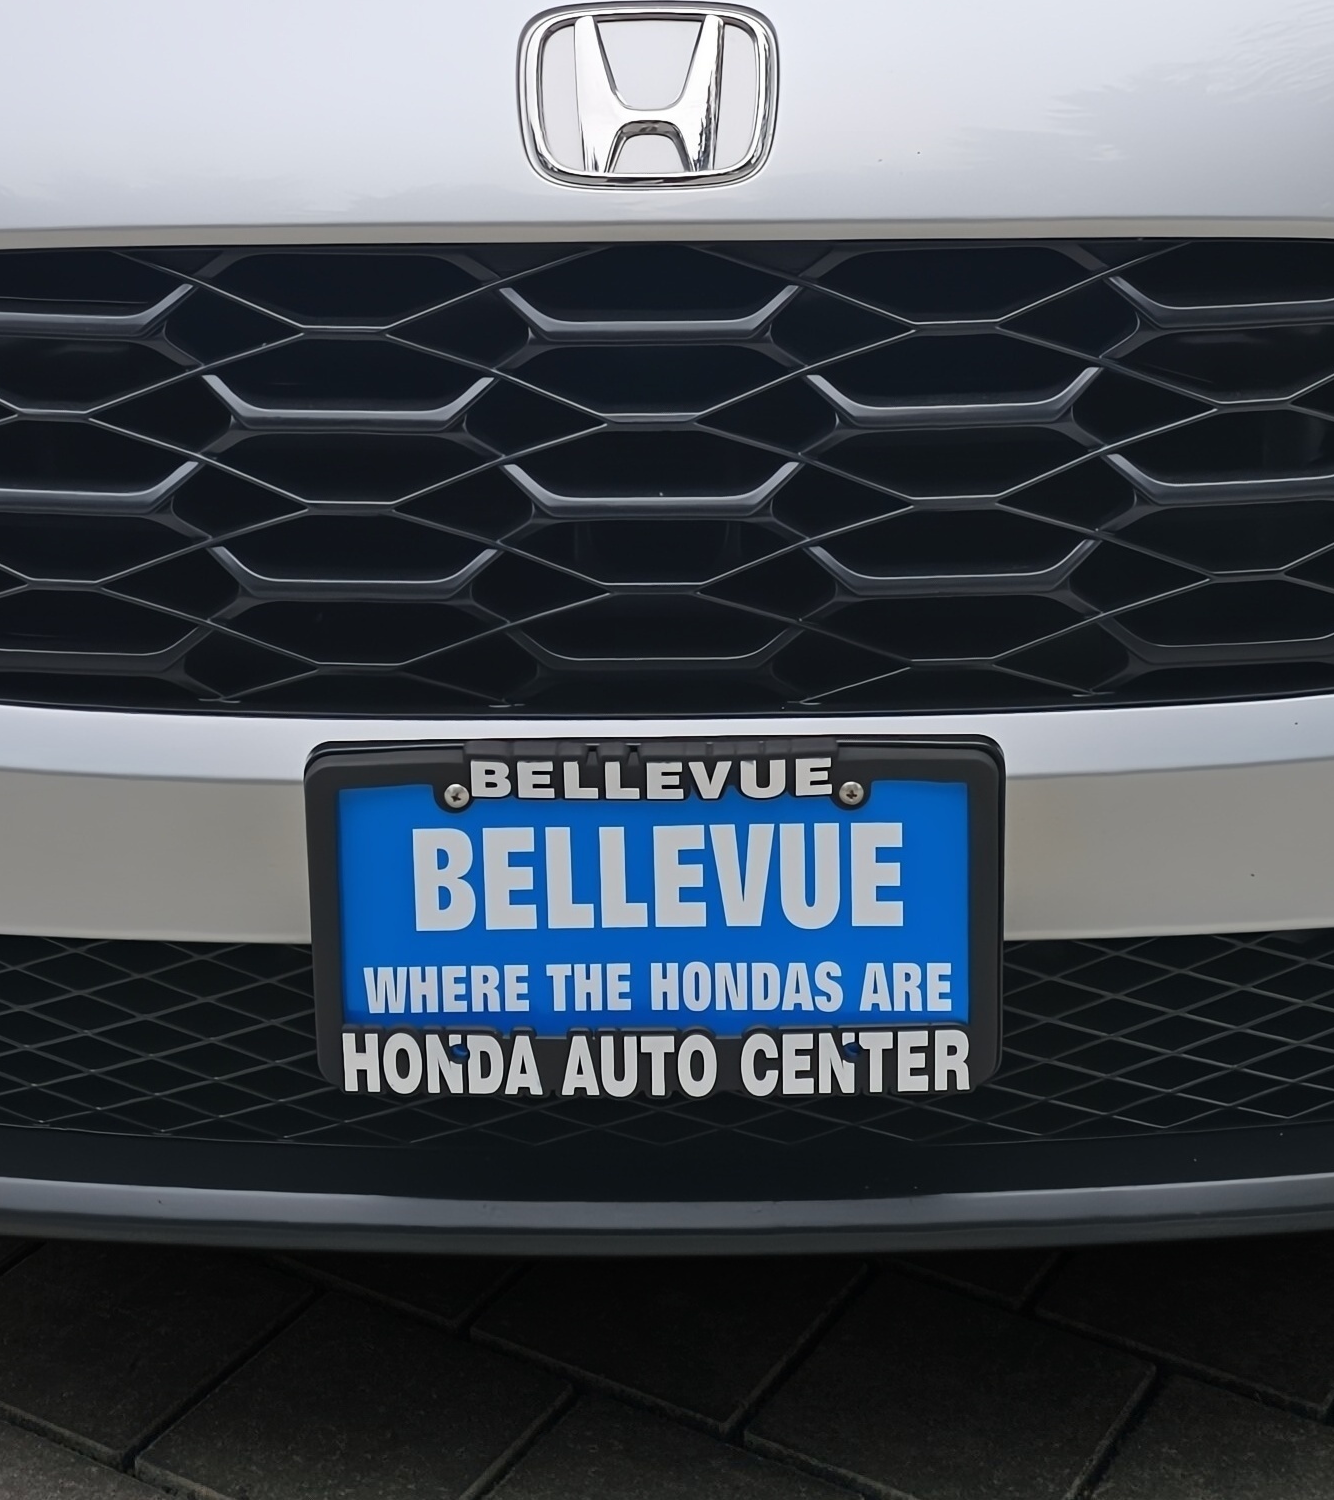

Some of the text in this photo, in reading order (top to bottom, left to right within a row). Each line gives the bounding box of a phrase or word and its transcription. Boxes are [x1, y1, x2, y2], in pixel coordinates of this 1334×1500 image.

[470, 758, 834, 800] BELLEVUE
[412, 822, 904, 932] BELLEVUE
[363, 961, 952, 1014] WHERE THE HONDAS ARE
[341, 1029, 971, 1097] HONDA AUTO CENTER
